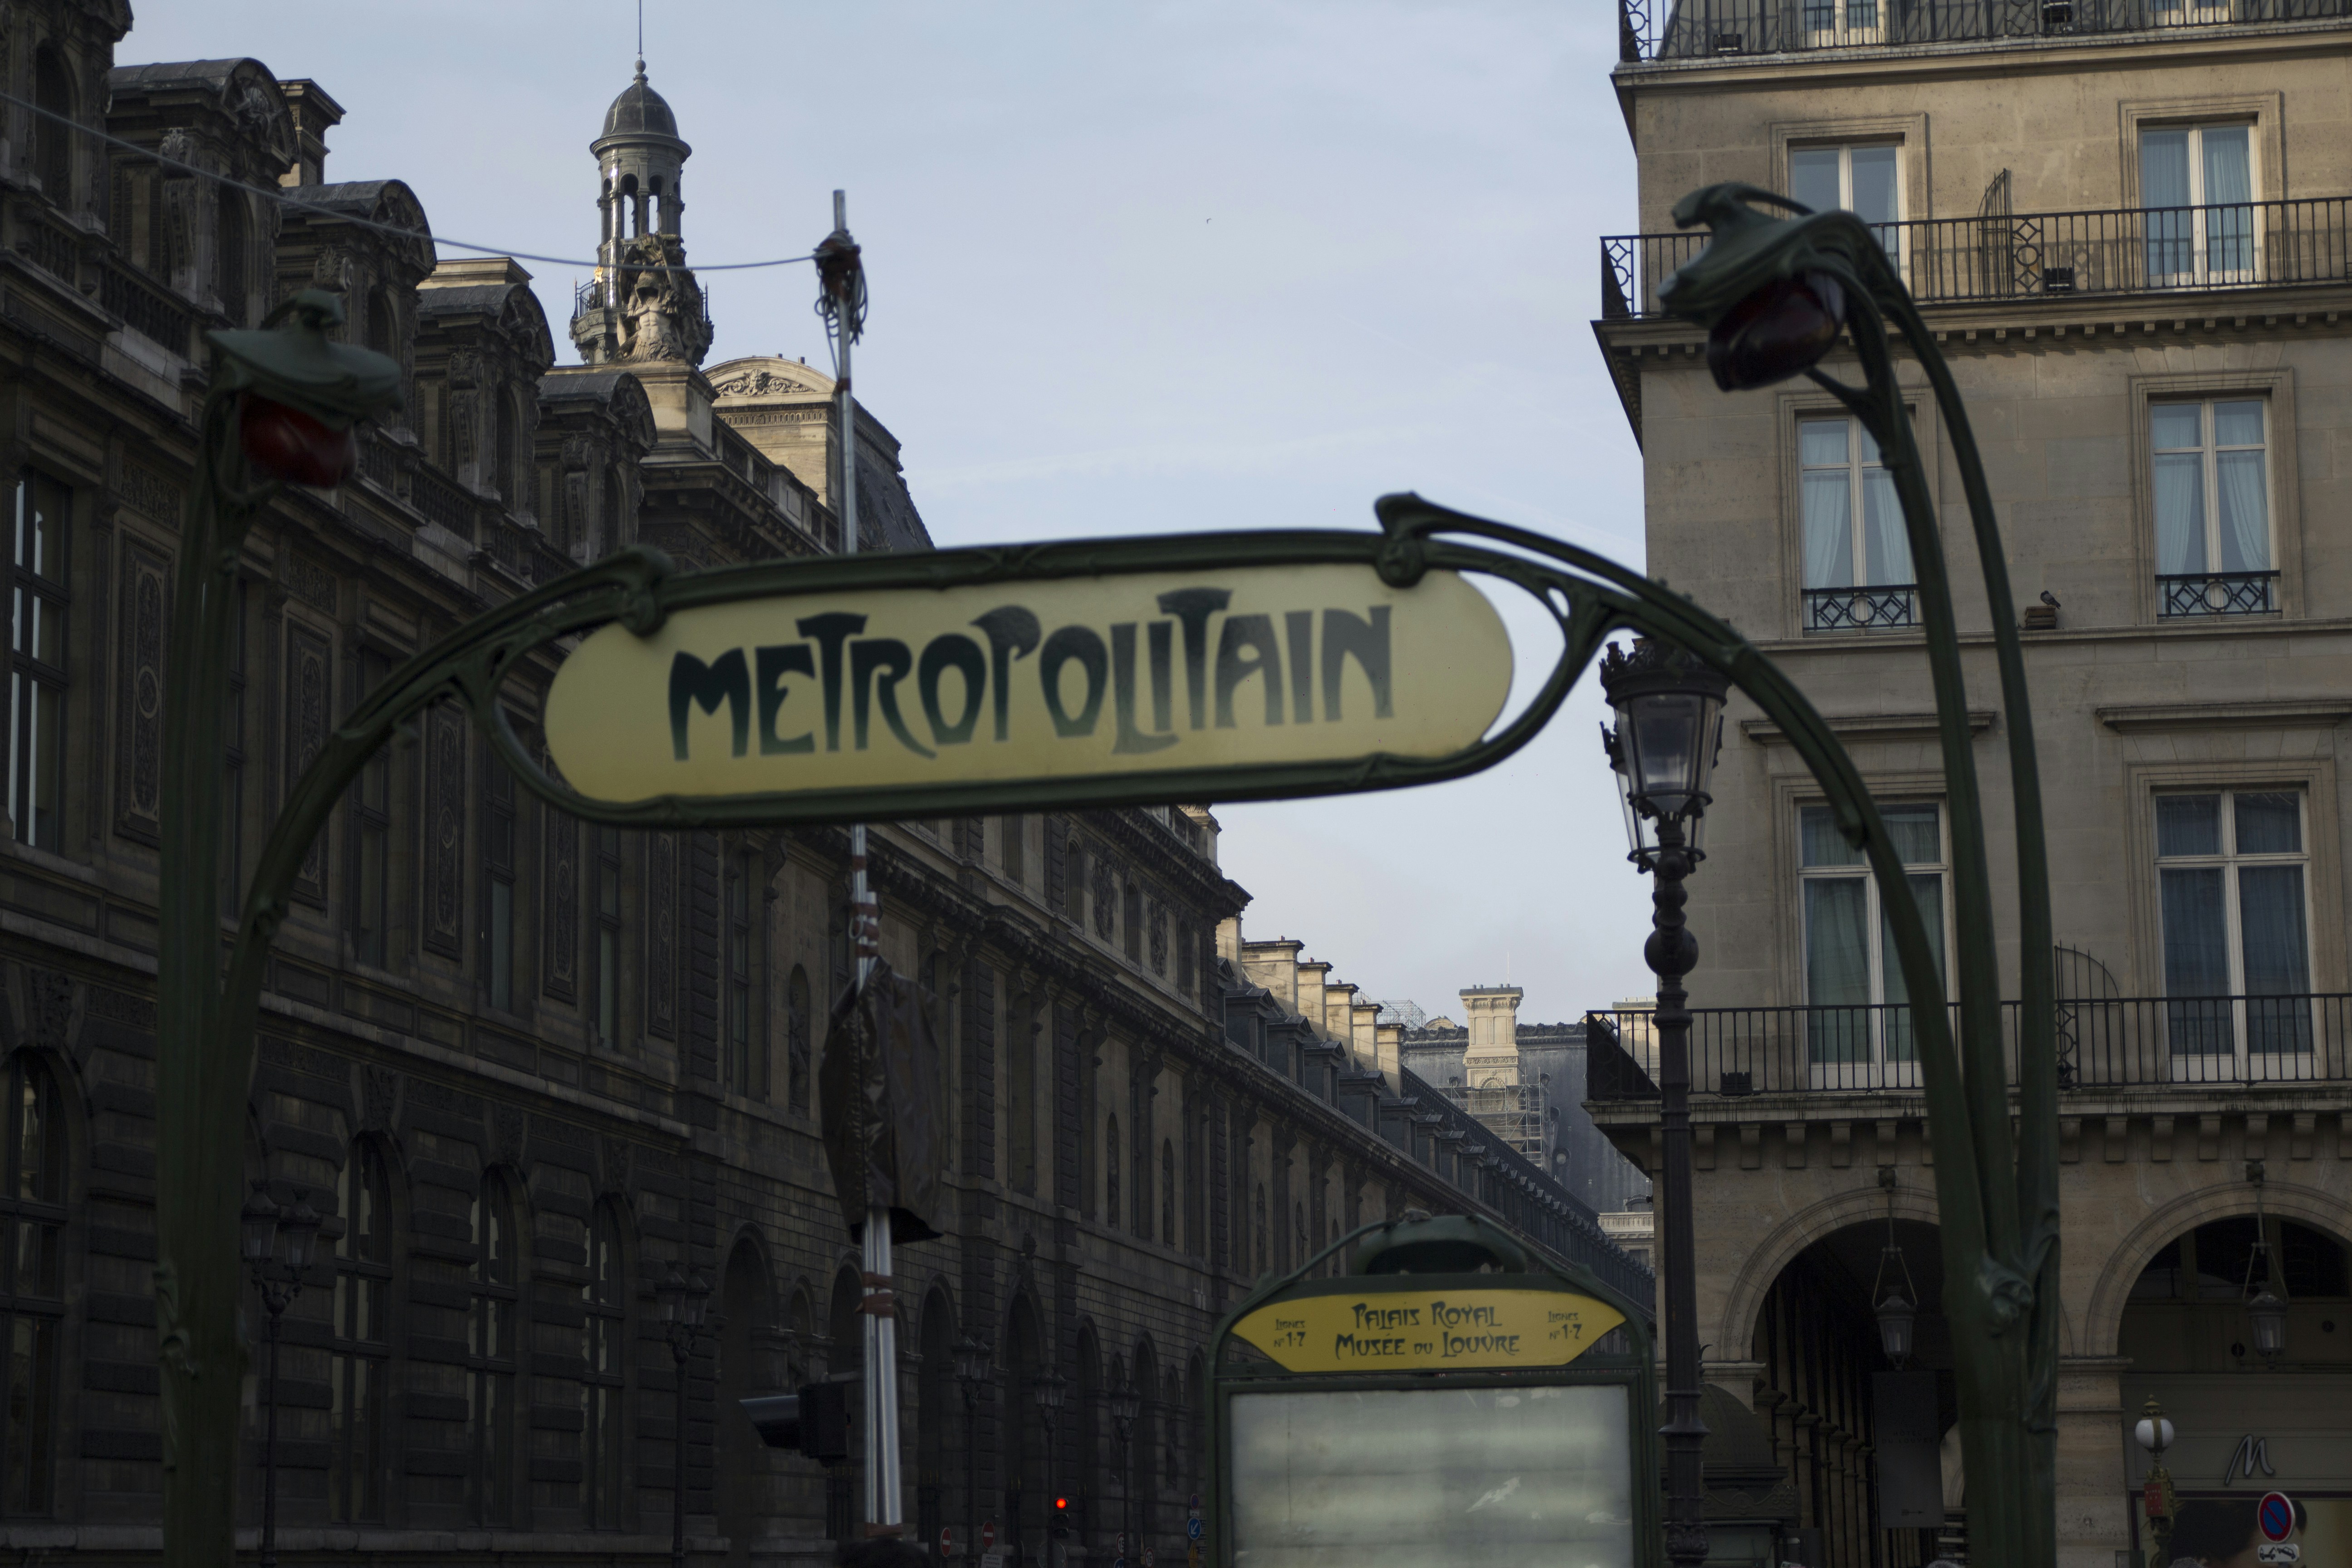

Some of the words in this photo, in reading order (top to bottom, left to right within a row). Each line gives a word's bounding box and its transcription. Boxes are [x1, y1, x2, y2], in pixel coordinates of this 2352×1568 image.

[668, 587, 1394, 761] METROPOLITAIN
[1275, 1319, 1305, 1331] LIGNES
[1352, 1303, 1420, 1330] PALAIS
[1431, 1301, 1503, 1328] ROYAL
[1548, 1311, 1578, 1323] LIGNES
[1335, 1333, 1405, 1360] MUSÉE
[1414, 1342, 1433, 1355] DU
[1441, 1330, 1520, 1357] LOUVRE
[1147, 1554, 1152, 1564] 15
